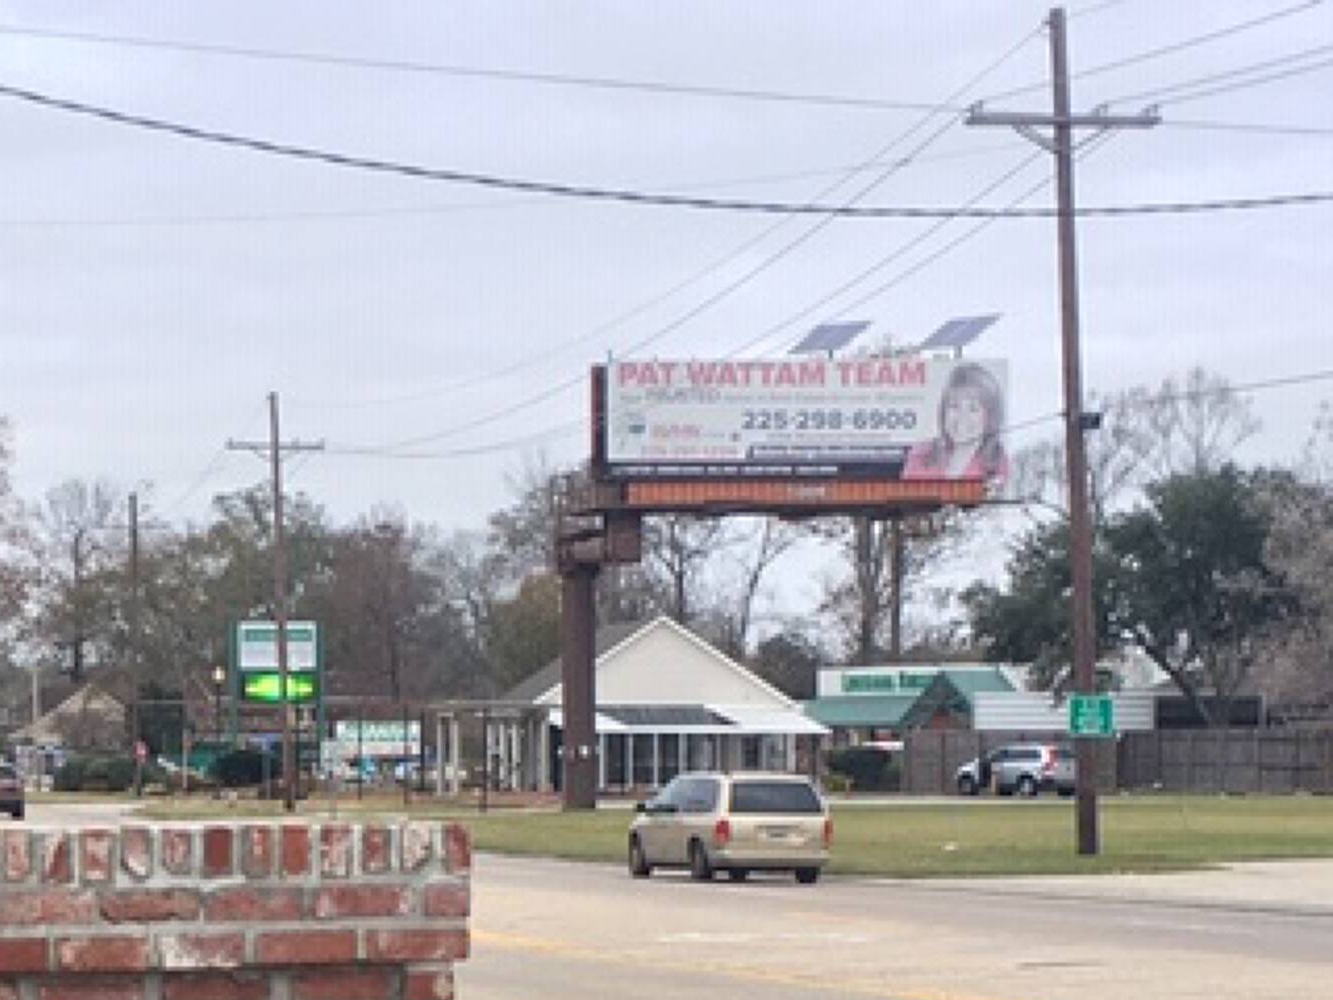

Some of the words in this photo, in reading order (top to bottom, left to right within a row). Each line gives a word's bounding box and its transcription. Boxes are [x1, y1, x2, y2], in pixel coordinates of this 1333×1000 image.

[618, 362, 678, 387] PAT
[686, 362, 826, 387] WATTAM
[837, 362, 927, 387] TEAM
